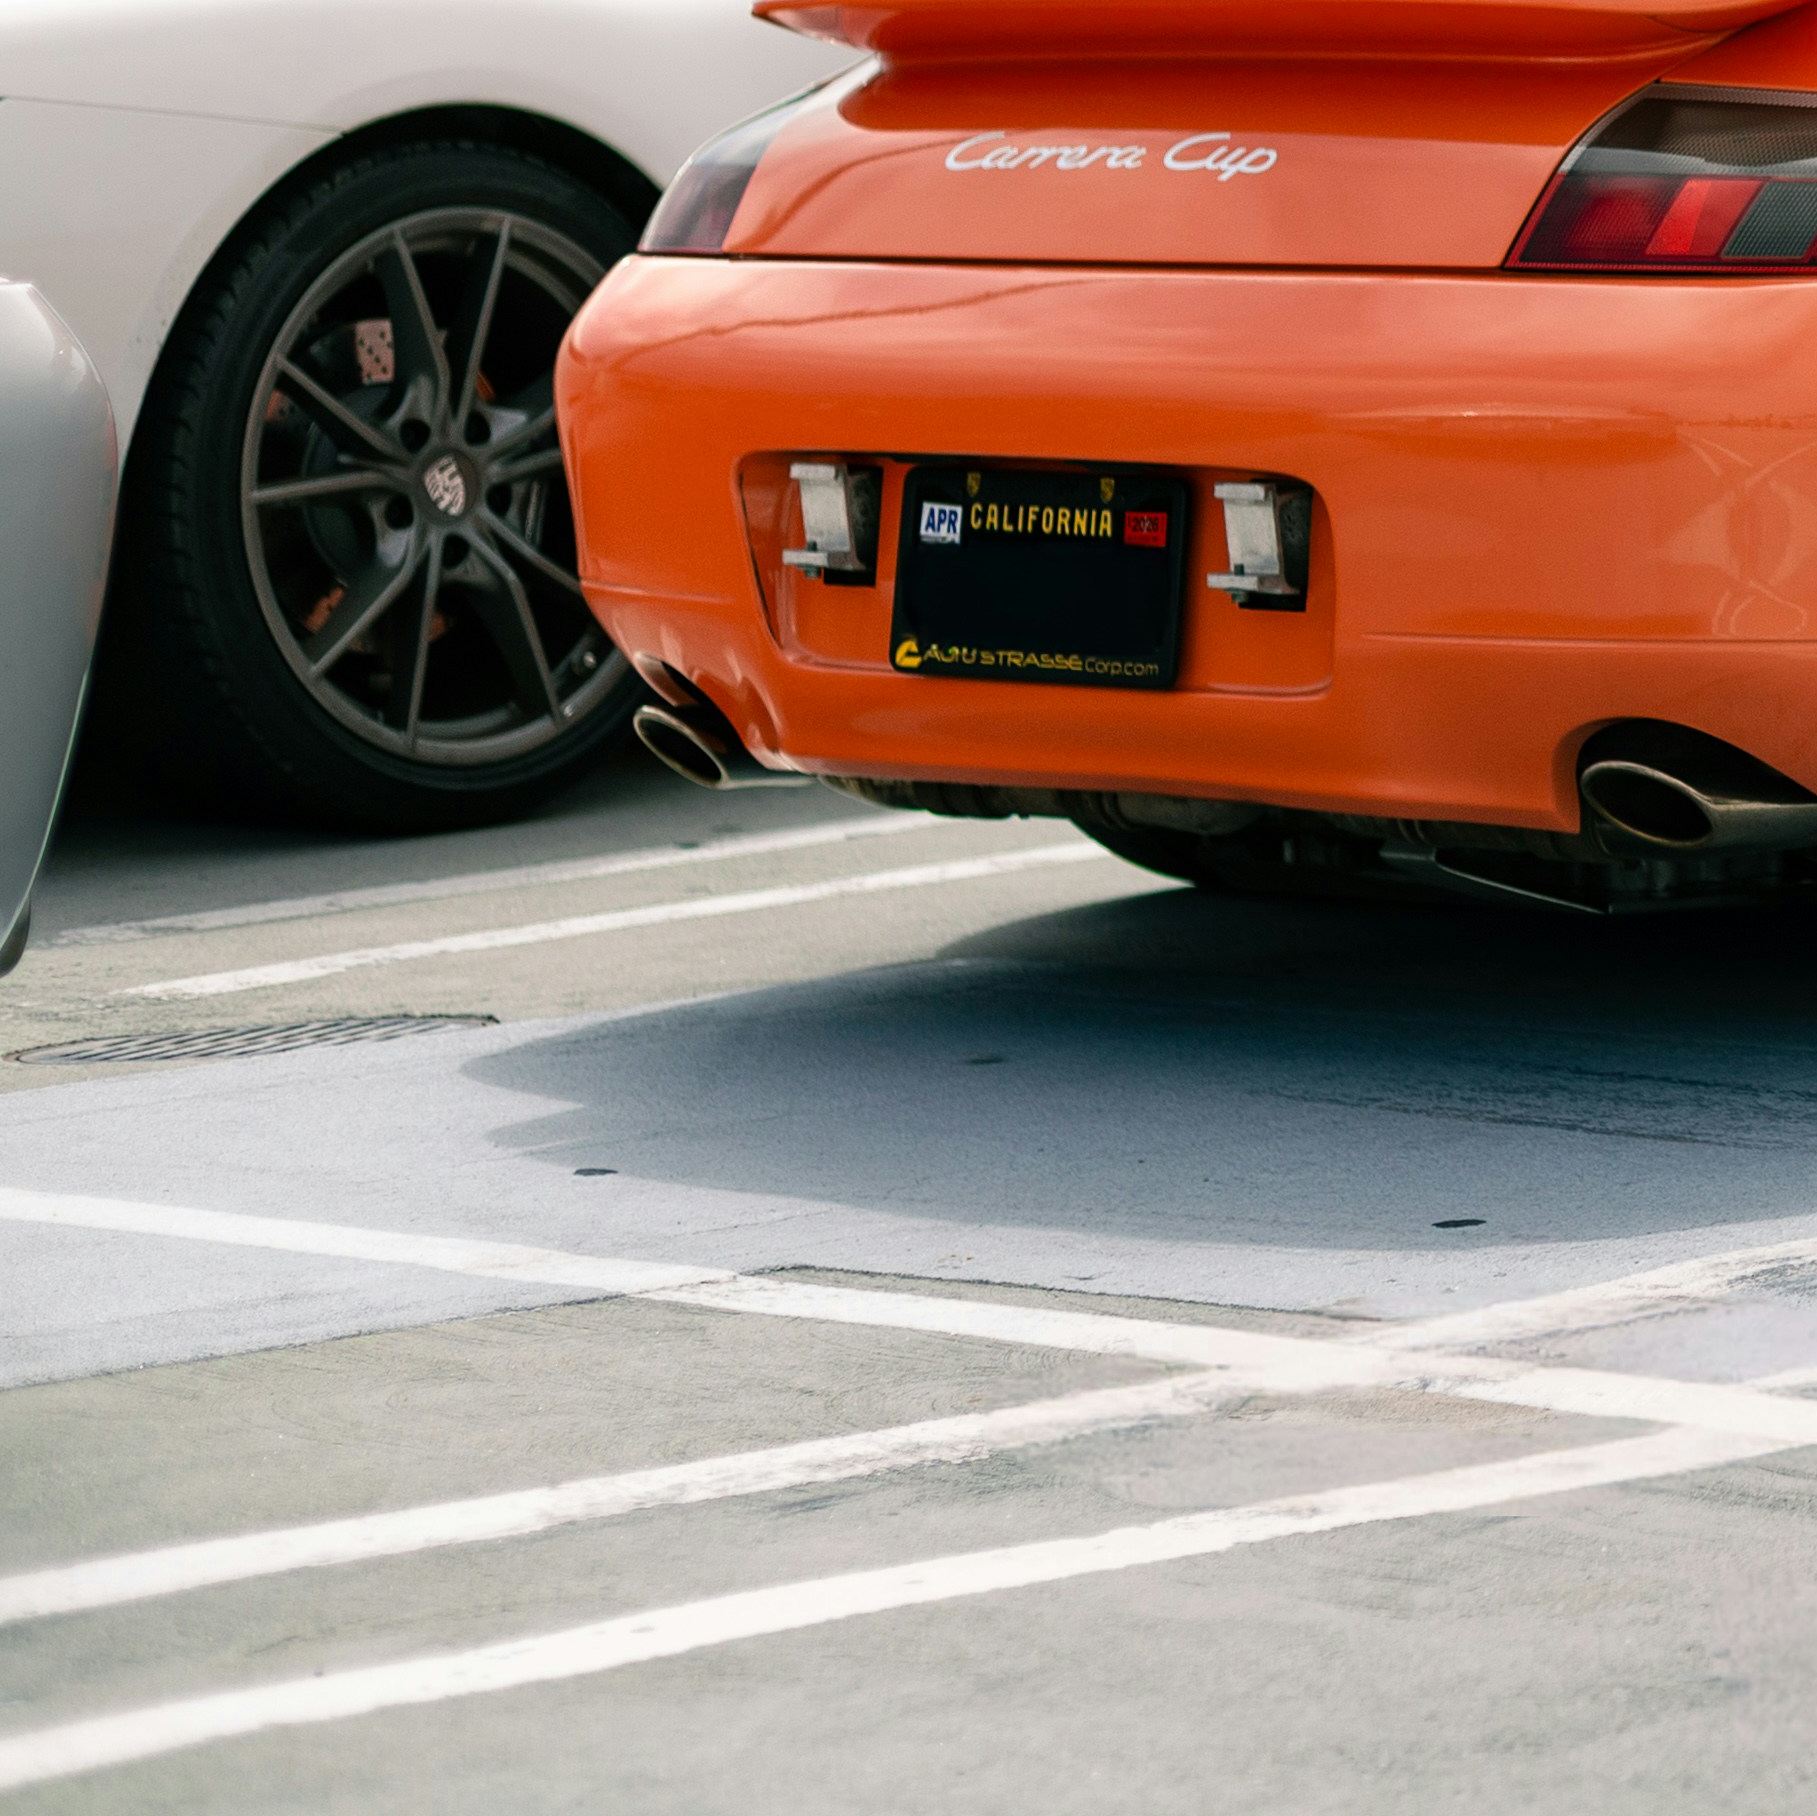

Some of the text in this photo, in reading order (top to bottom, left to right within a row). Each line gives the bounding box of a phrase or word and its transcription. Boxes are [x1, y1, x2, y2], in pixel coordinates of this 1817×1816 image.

[945, 131, 1278, 182] Carrera Cup
[925, 506, 959, 535] APR
[970, 502, 1113, 538] CALIFORNIA
